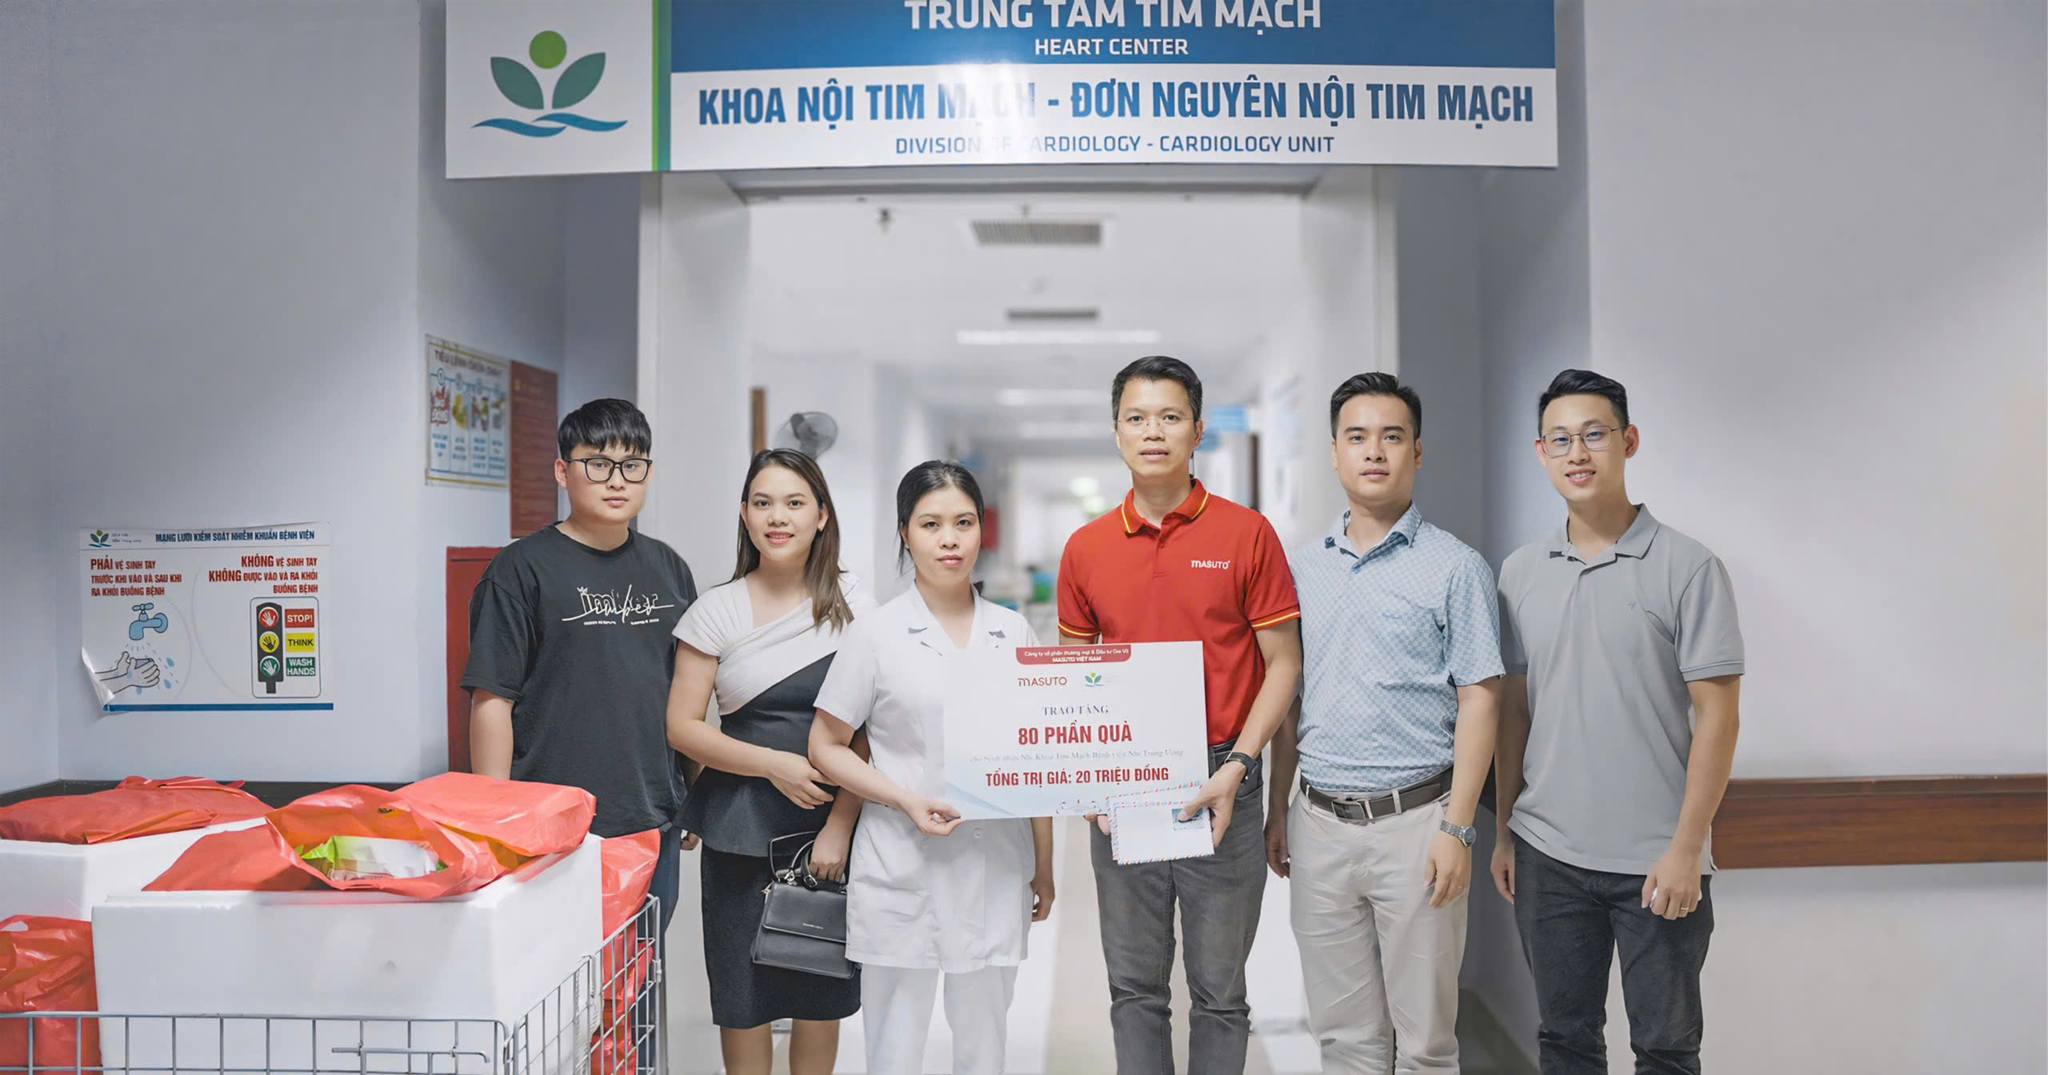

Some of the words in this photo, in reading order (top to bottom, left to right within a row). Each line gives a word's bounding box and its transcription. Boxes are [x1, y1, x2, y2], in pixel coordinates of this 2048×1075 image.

[904, 0, 1033, 29] TRUNG
[1135, 0, 1202, 27] TIM
[1214, 0, 1321, 35] MẠCH
[1035, 38, 1103, 55] HEART
[1109, 38, 1188, 55] CENTER
[699, 87, 786, 125] KHOA
[797, 78, 853, 130] NỘI
[865, 84, 924, 120] TIM
[1070, 78, 1140, 118] ĐƠN
[1152, 74, 1287, 118] NGUYÊN
[1299, 75, 1355, 127] NỘI
[1366, 83, 1425, 120] TIM
[1437, 84, 1533, 129] MẠCH
[1022, 136, 1141, 152] ARDIOLOGY
[1160, 136, 1282, 152] CARDIOLOGY
[1288, 136, 1334, 153] UNIT
[125, 561, 143, 569] SINH
[144, 560, 156, 569] TAY
[241, 553, 274, 568] KHÔNG
[286, 558, 304, 566] SINH
[306, 558, 318, 566] TAY
[115, 575, 127, 583] KHI
[155, 574, 168, 583] SAU
[170, 574, 182, 582] KHI
[209, 567, 242, 582] KHÔNG
[290, 572, 299, 580] RA
[91, 588, 100, 596] RA
[287, 614, 313, 623] STOP!
[288, 638, 314, 647] THINK
[288, 658, 313, 666] WASH
[1018, 727, 1039, 745] 80
[1044, 719, 1092, 744] PHẦN
[1098, 720, 1132, 744] QUÀ
[986, 767, 1019, 787] TỔNG
[1023, 772, 1042, 788] TRỊ
[1047, 768, 1071, 785] GIÁ:
[1076, 770, 1091, 783] 20
[1095, 765, 1130, 786] TRIỆU
